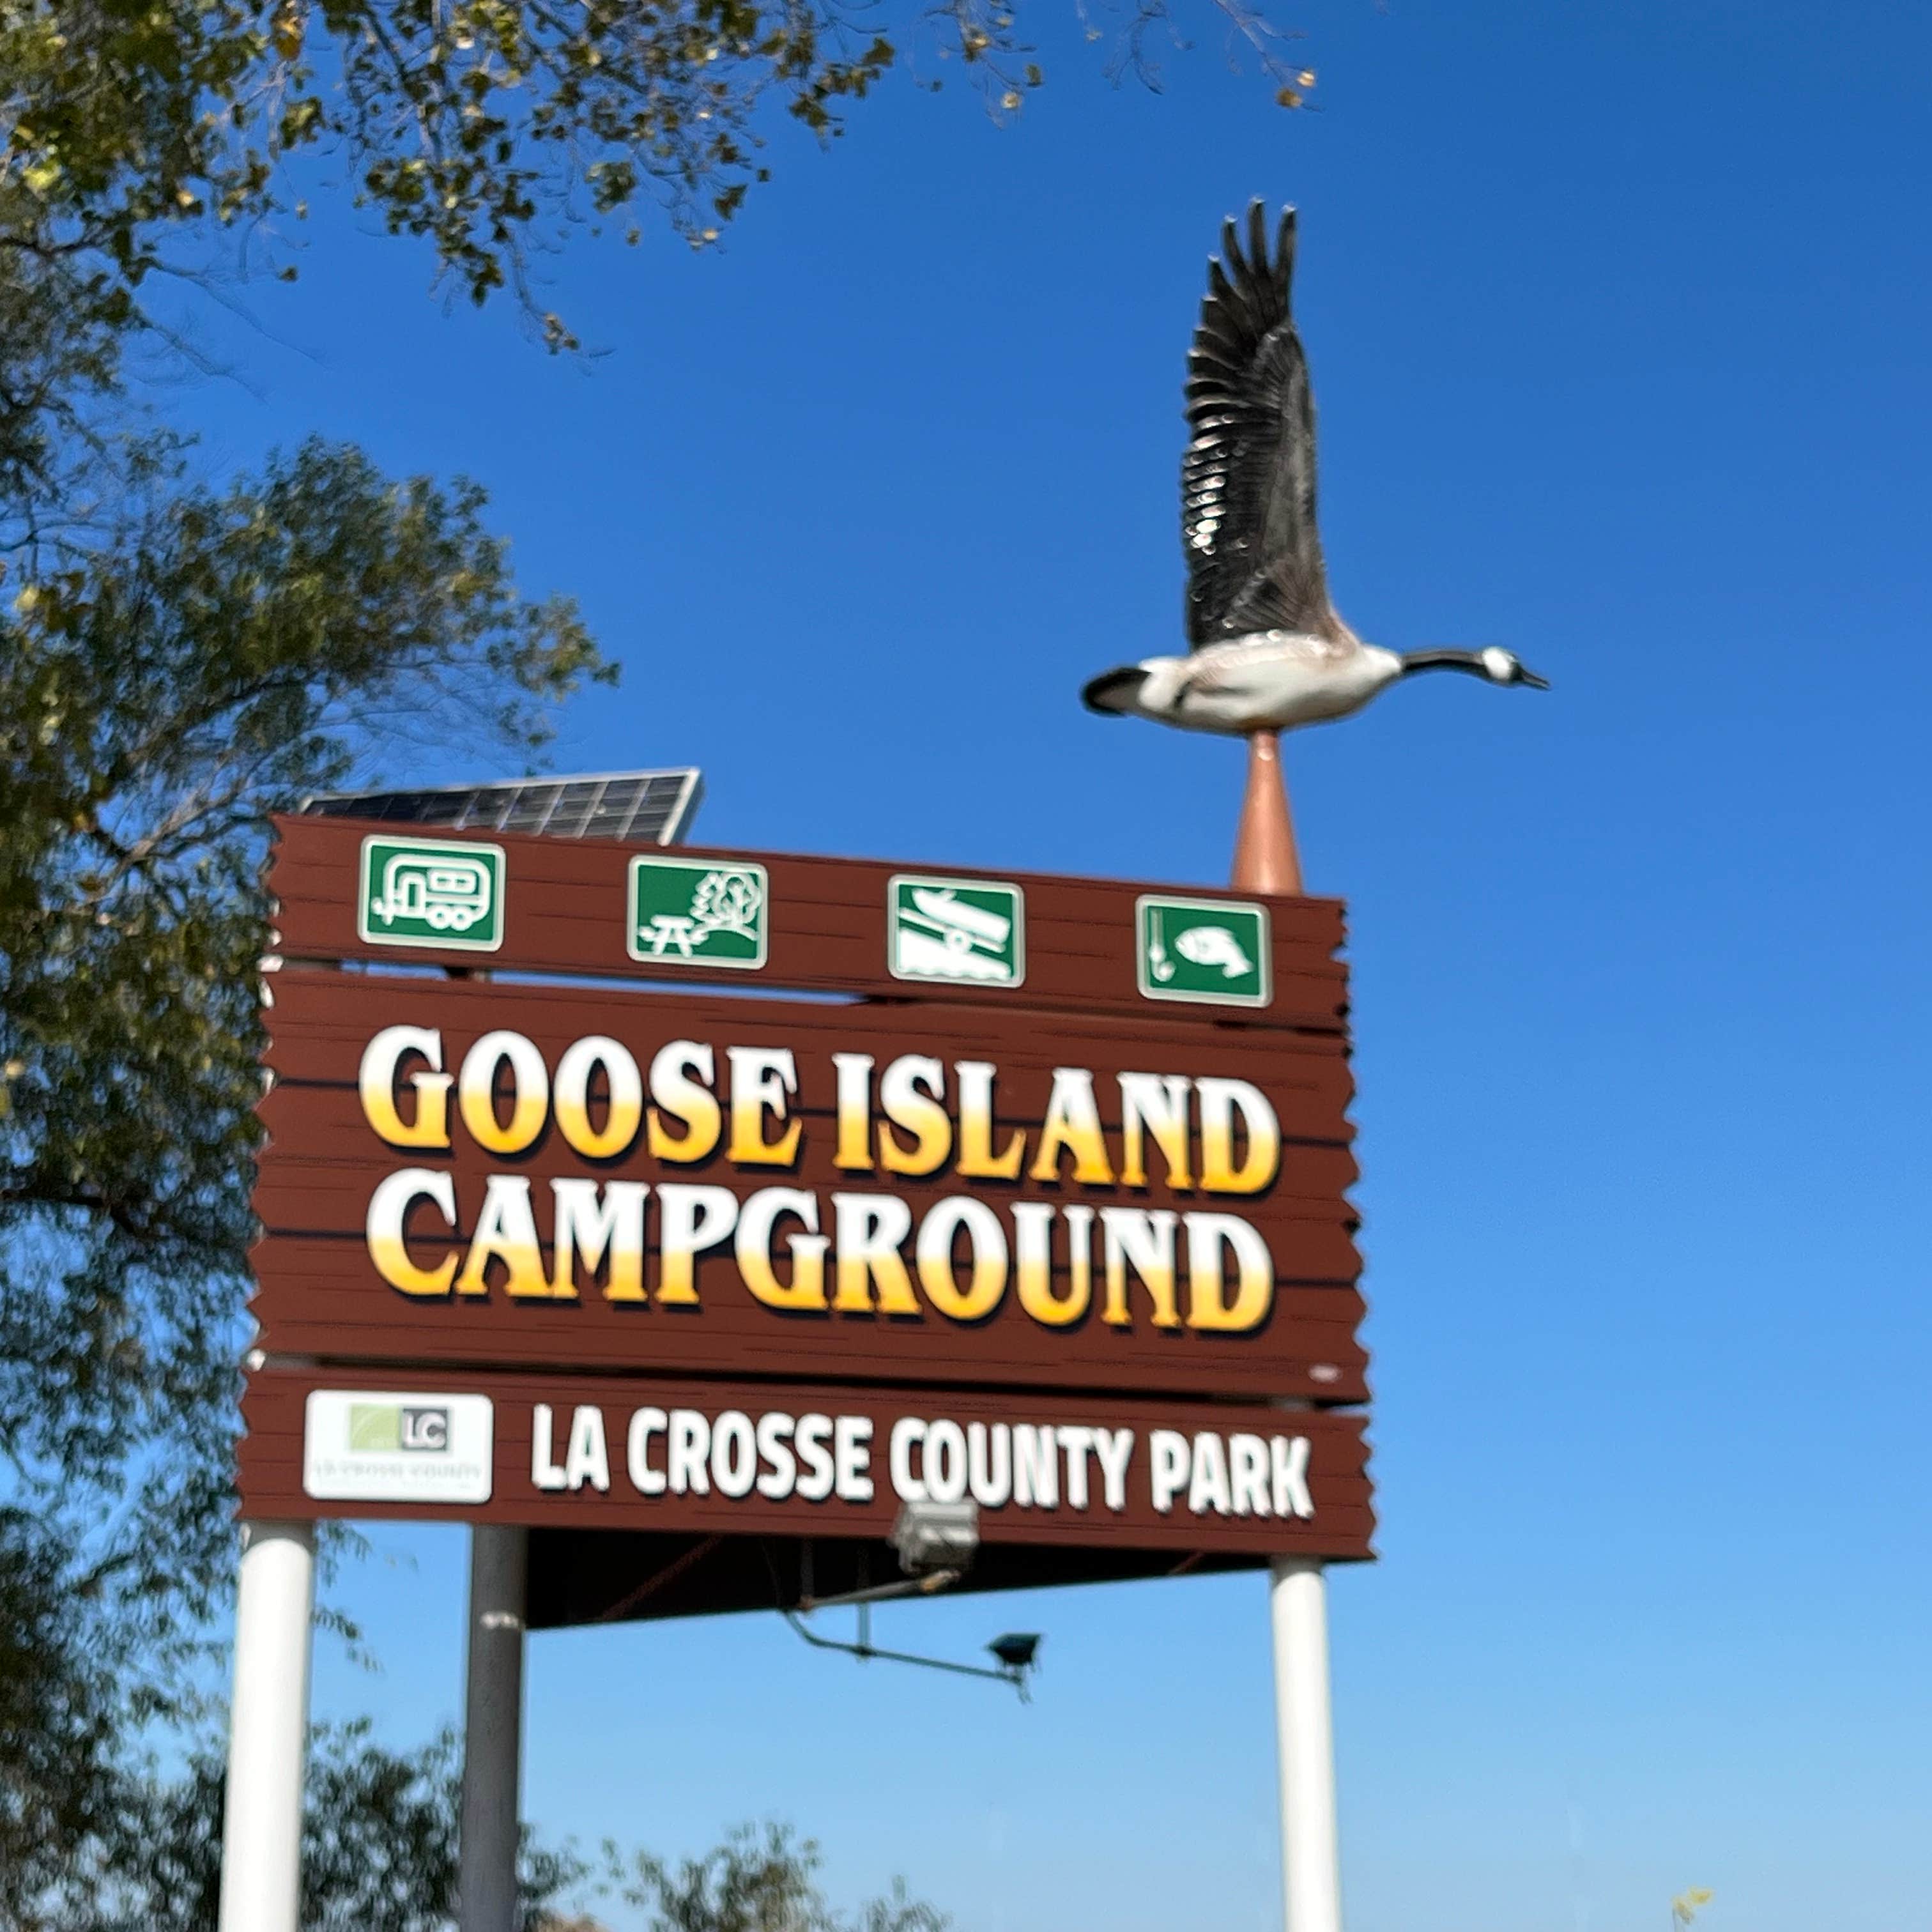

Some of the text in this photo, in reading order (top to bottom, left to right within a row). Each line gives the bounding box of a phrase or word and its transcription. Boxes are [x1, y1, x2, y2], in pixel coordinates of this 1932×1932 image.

[358, 1024, 1281, 1194] GOOSE ISLAND
[366, 1167, 1273, 1331] CAMPGROUND
[403, 1412, 446, 1448] LC
[531, 1403, 1314, 1519] LA CROSSE COUNTY PARK
